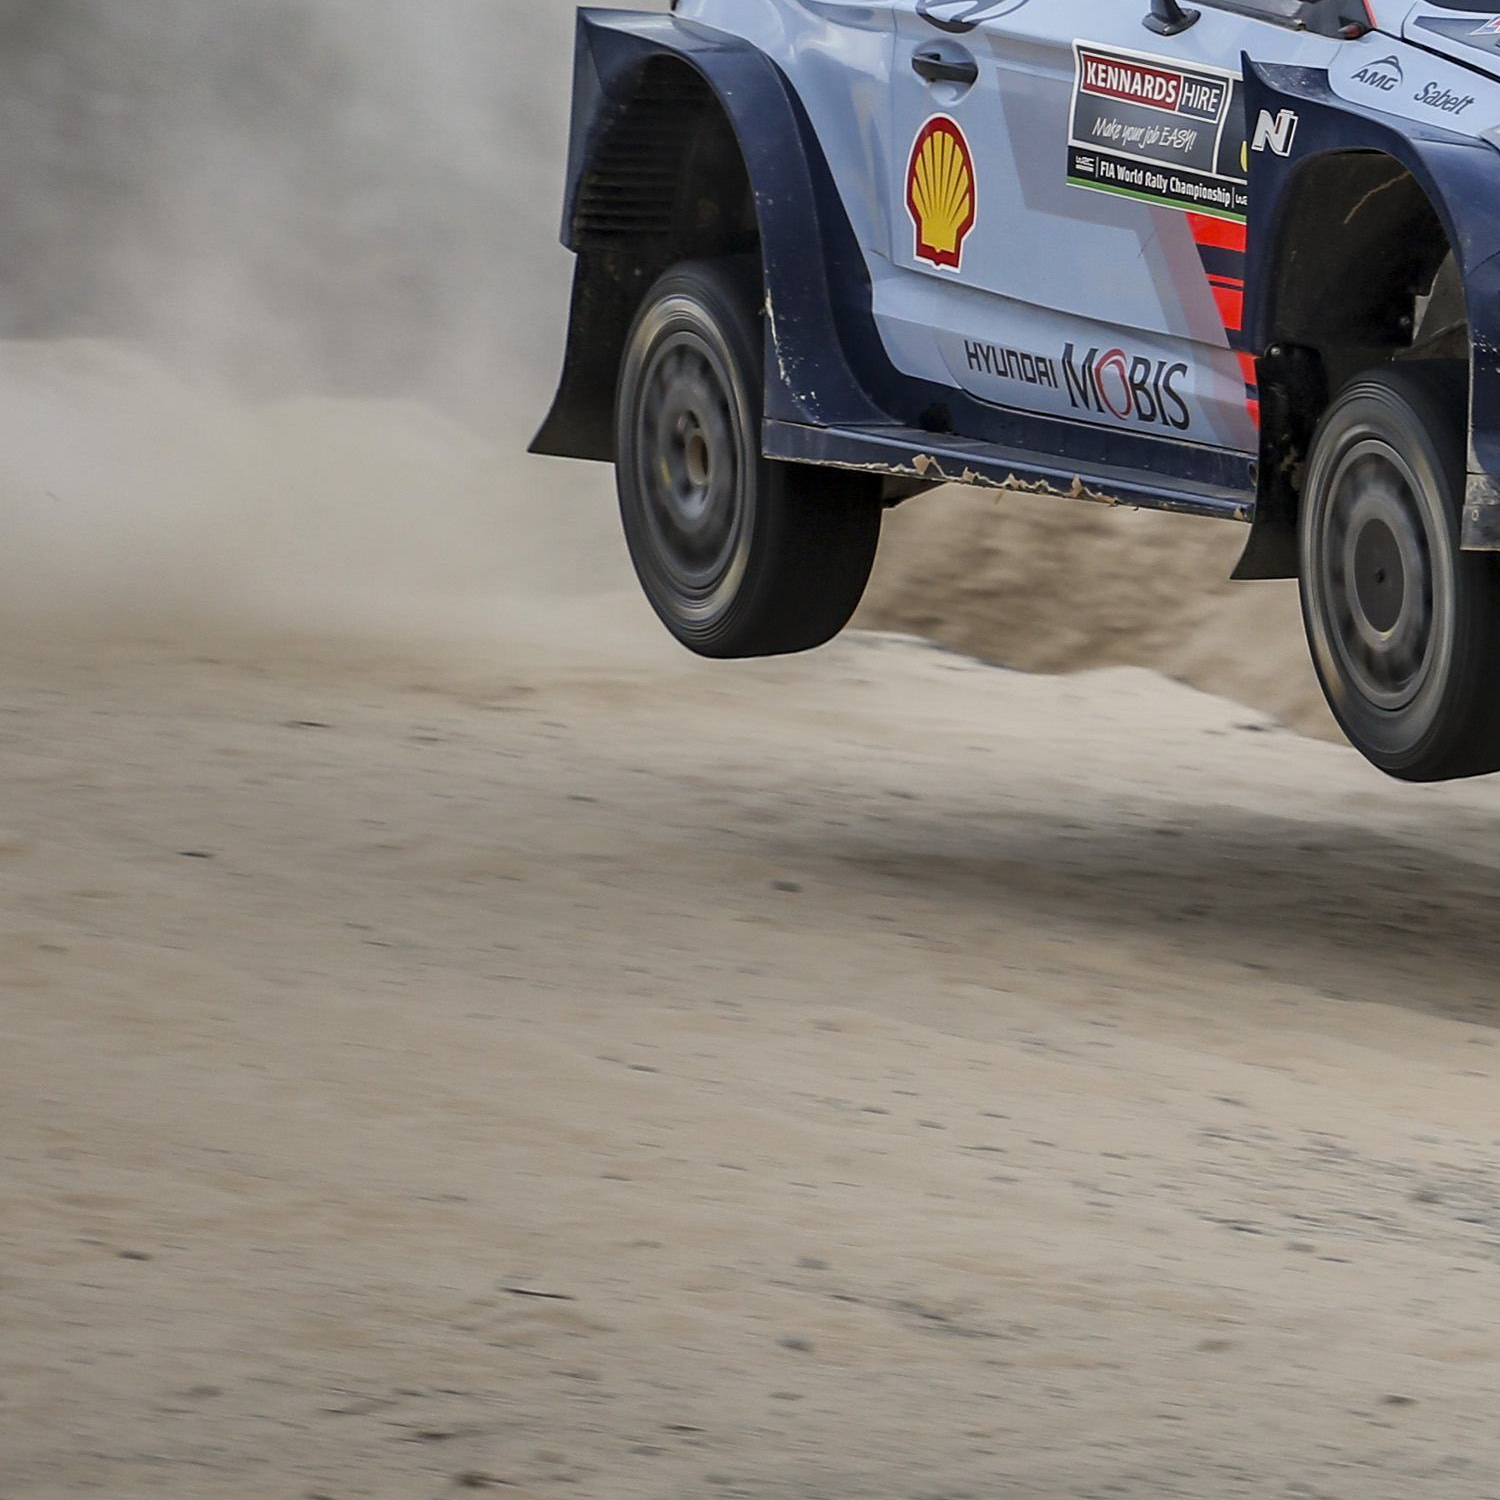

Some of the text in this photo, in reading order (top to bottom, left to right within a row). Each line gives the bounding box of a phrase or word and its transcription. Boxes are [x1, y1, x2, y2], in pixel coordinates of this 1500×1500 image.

[1085, 60, 1221, 114] KENNARDS HIRE
[1350, 67, 1400, 92] AMG
[1414, 81, 1477, 116] Sabelt
[1091, 116, 1199, 154] Make your job EASY!
[1100, 160, 1115, 179] FIA
[1116, 163, 1144, 186] World
[1144, 171, 1169, 194] Rally
[1169, 176, 1231, 207] Championship
[964, 339, 1191, 431] HYUNDAI MOBIS
